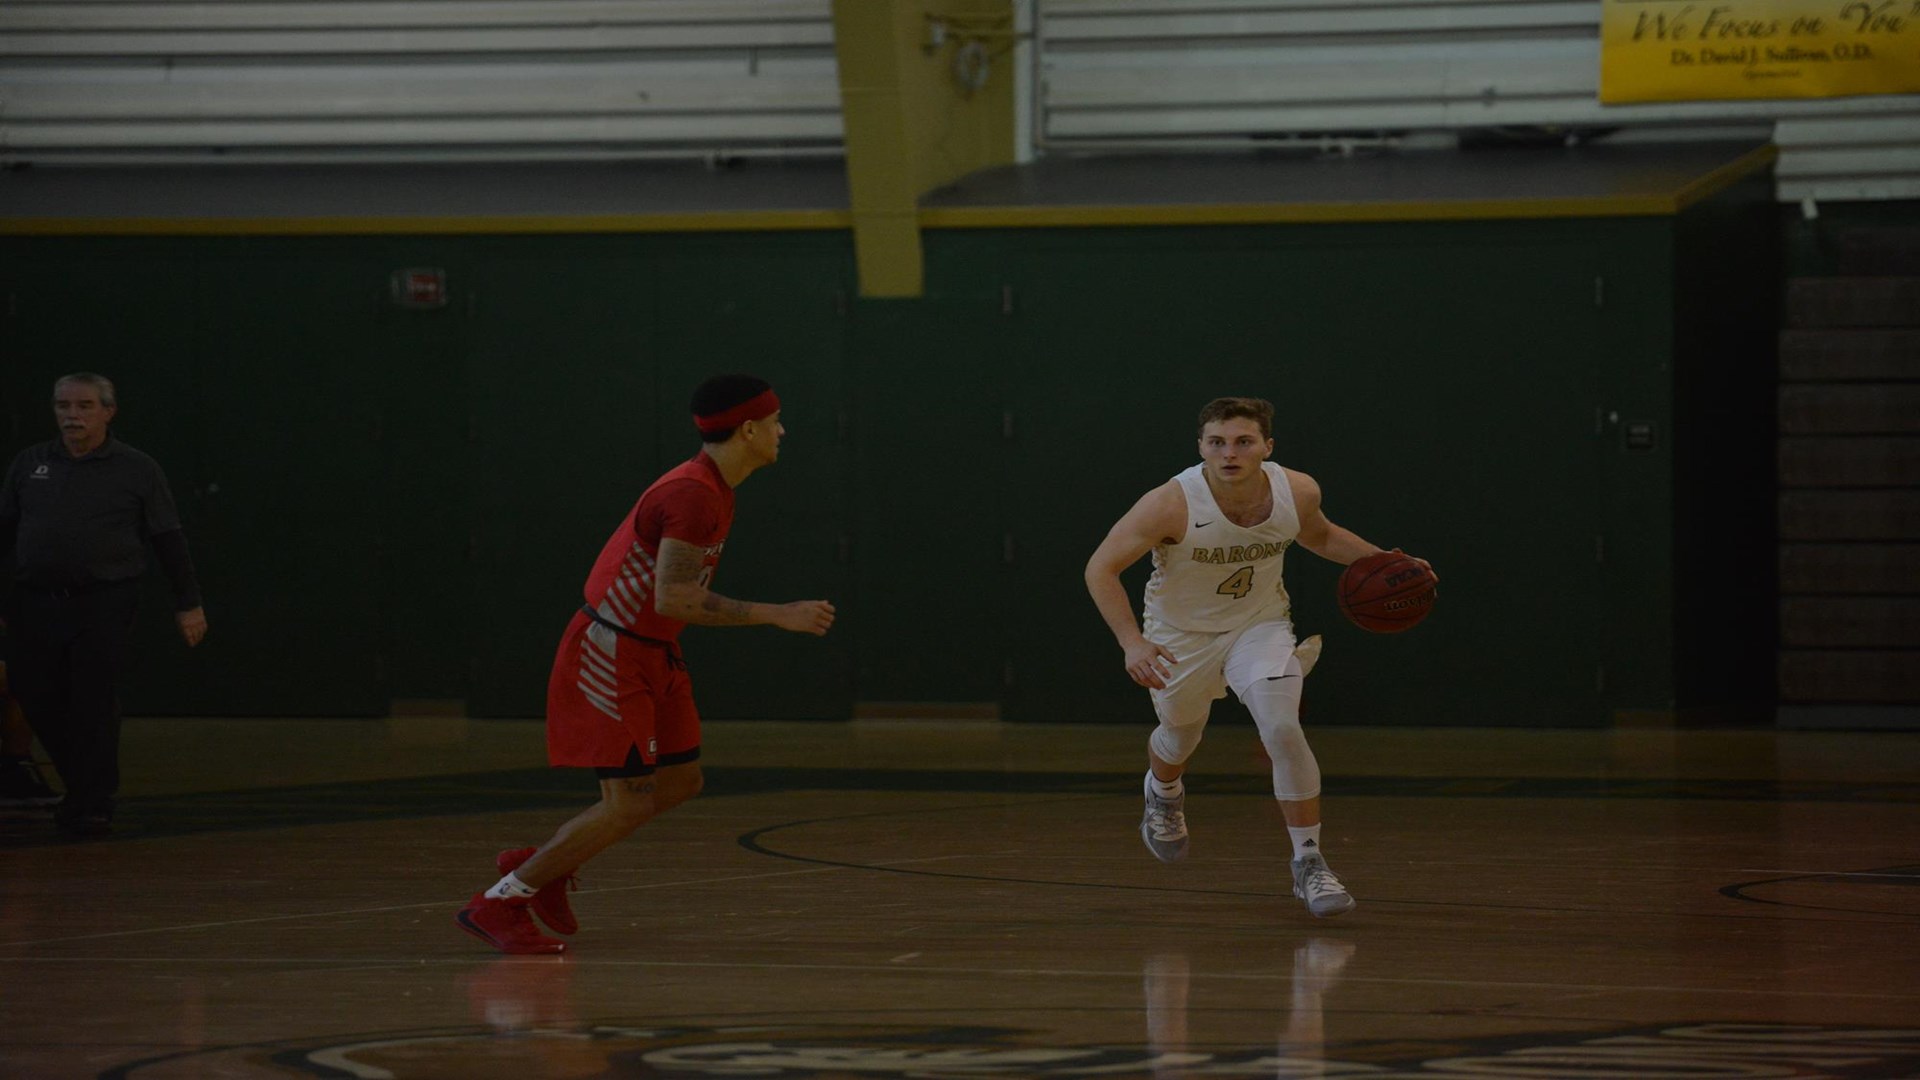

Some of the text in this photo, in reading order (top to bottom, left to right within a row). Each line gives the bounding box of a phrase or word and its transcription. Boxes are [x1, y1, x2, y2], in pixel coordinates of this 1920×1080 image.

[1631, 5, 1695, 41] We
[1698, 5, 1780, 38] Focus
[1789, 16, 1826, 35] on
[1216, 565, 1254, 600] 4
